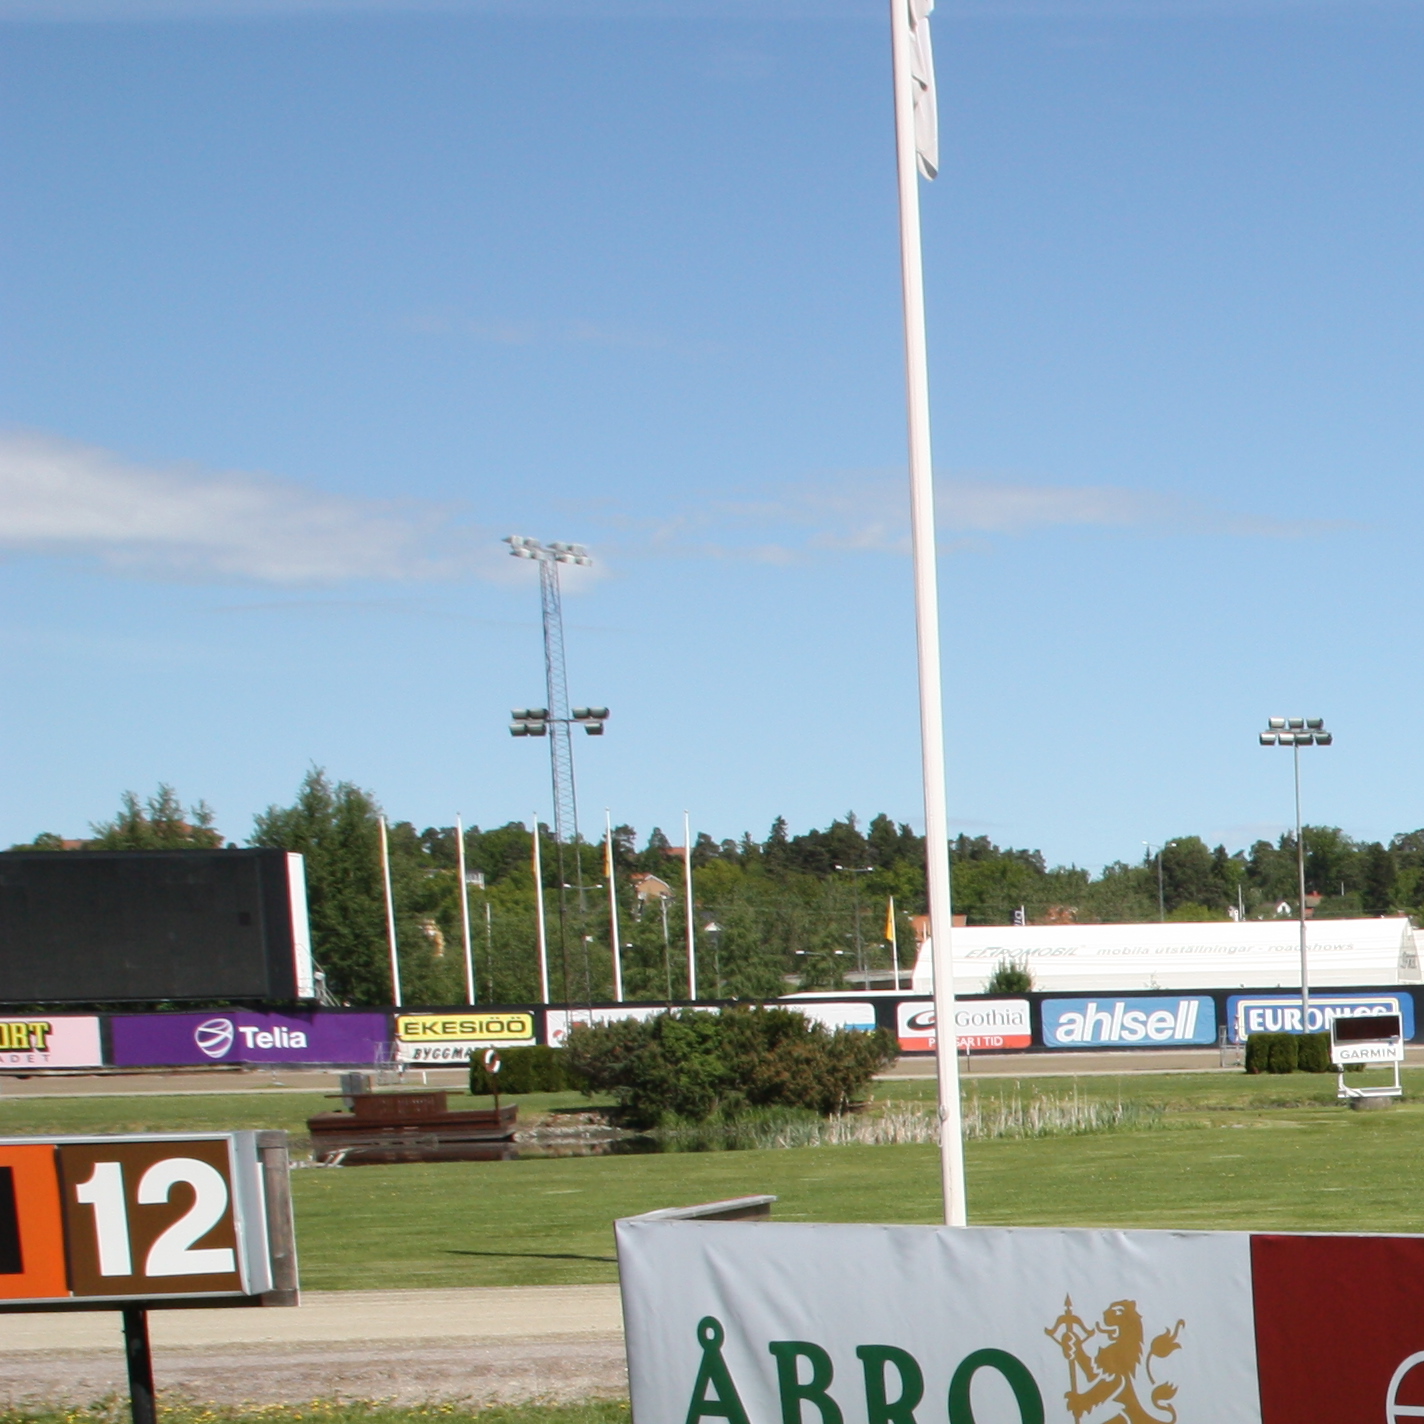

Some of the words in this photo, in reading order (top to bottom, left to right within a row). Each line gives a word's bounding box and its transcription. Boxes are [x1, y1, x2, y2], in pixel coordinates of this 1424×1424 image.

[1096, 945, 1149, 956] mobila
[1154, 944, 1254, 955] utställningar
[404, 1016, 526, 1035] EKESIÖÖ
[955, 1007, 1024, 1027] Gothia
[1054, 1000, 1200, 1042] ahlsell
[239, 1026, 307, 1049] Telia
[929, 1036, 975, 1048] PGAR
[982, 1036, 1003, 1047] TID
[1340, 1048, 1397, 1060] GARMIN
[76, 1157, 236, 1277] 12
